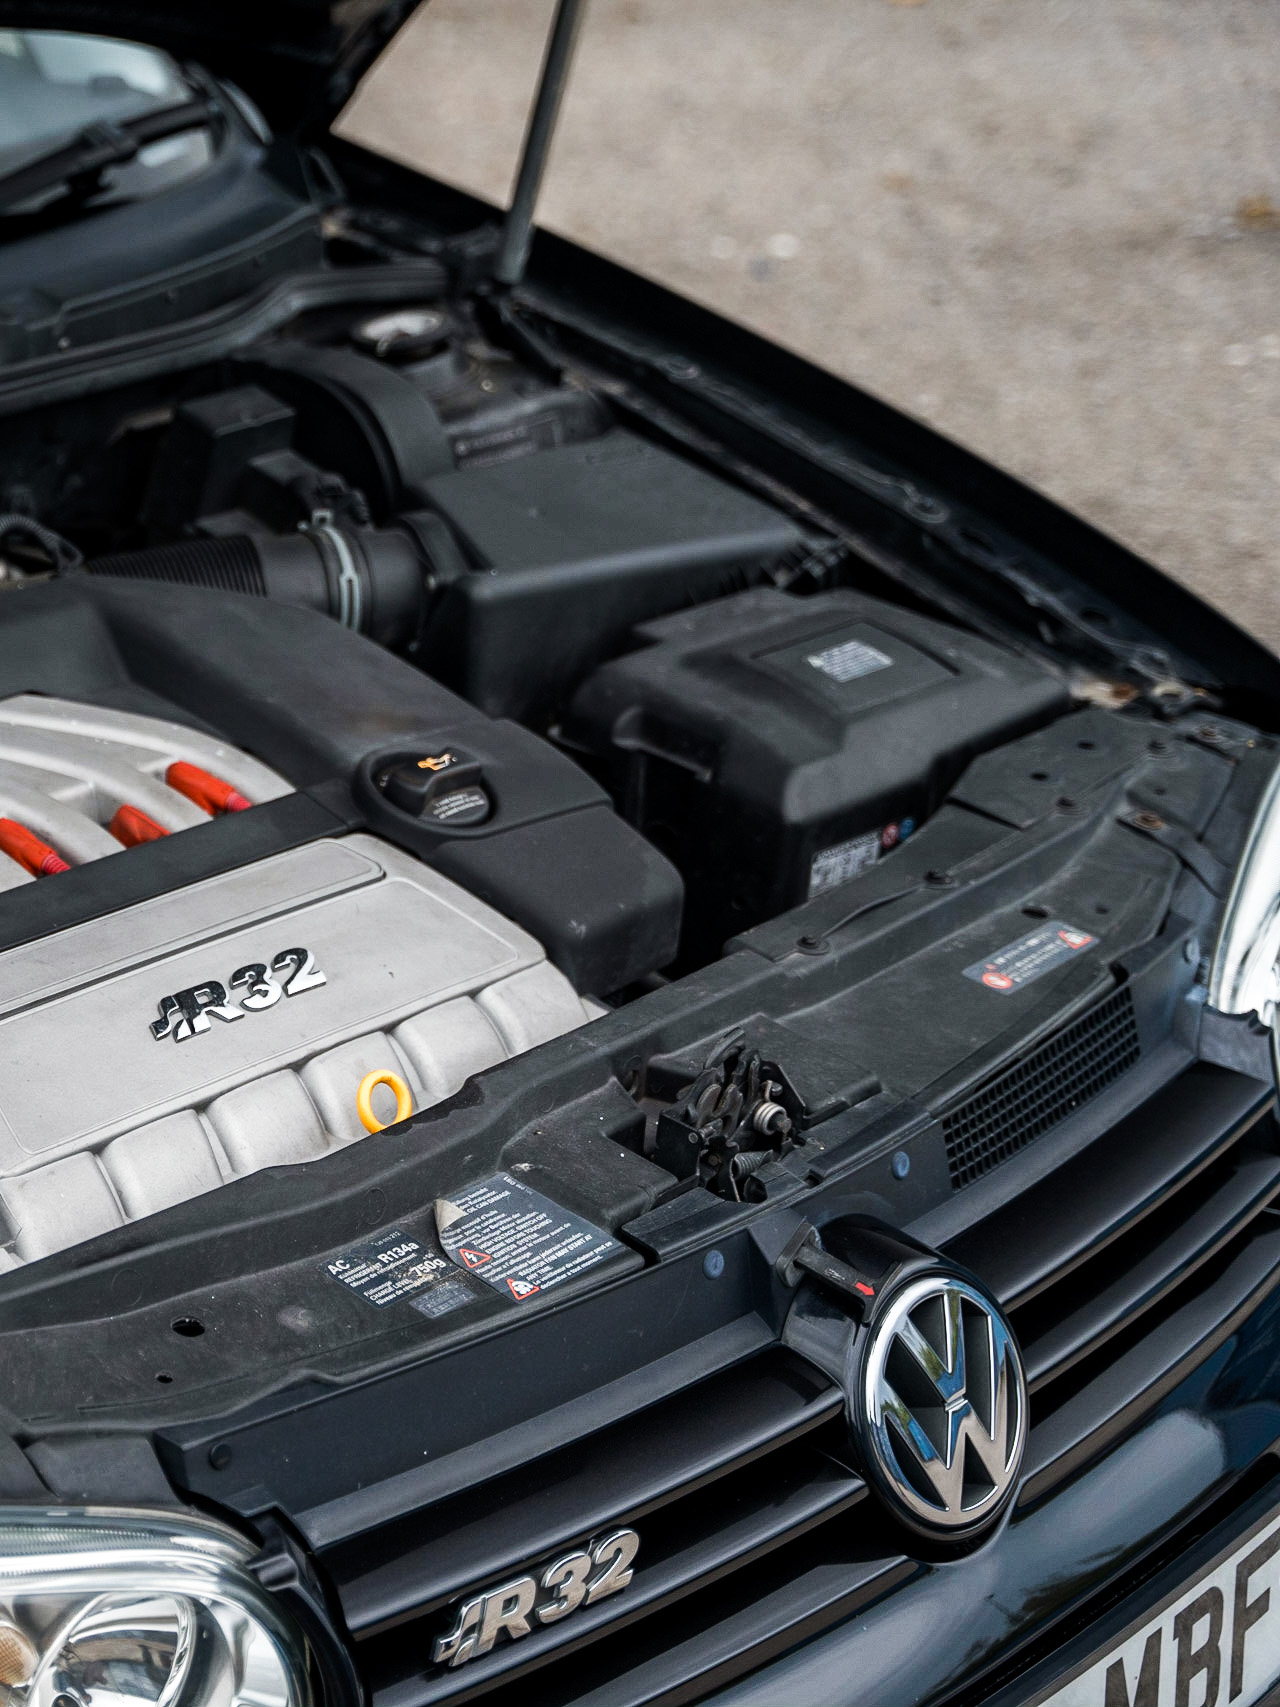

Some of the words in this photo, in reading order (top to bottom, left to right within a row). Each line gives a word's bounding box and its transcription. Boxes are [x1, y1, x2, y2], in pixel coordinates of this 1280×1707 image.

[149, 947, 327, 1043] R32
[377, 1243, 419, 1263] R134a
[567, 1238, 587, 1250] START
[328, 1260, 350, 1275] AC
[430, 1529, 639, 1666] R32
